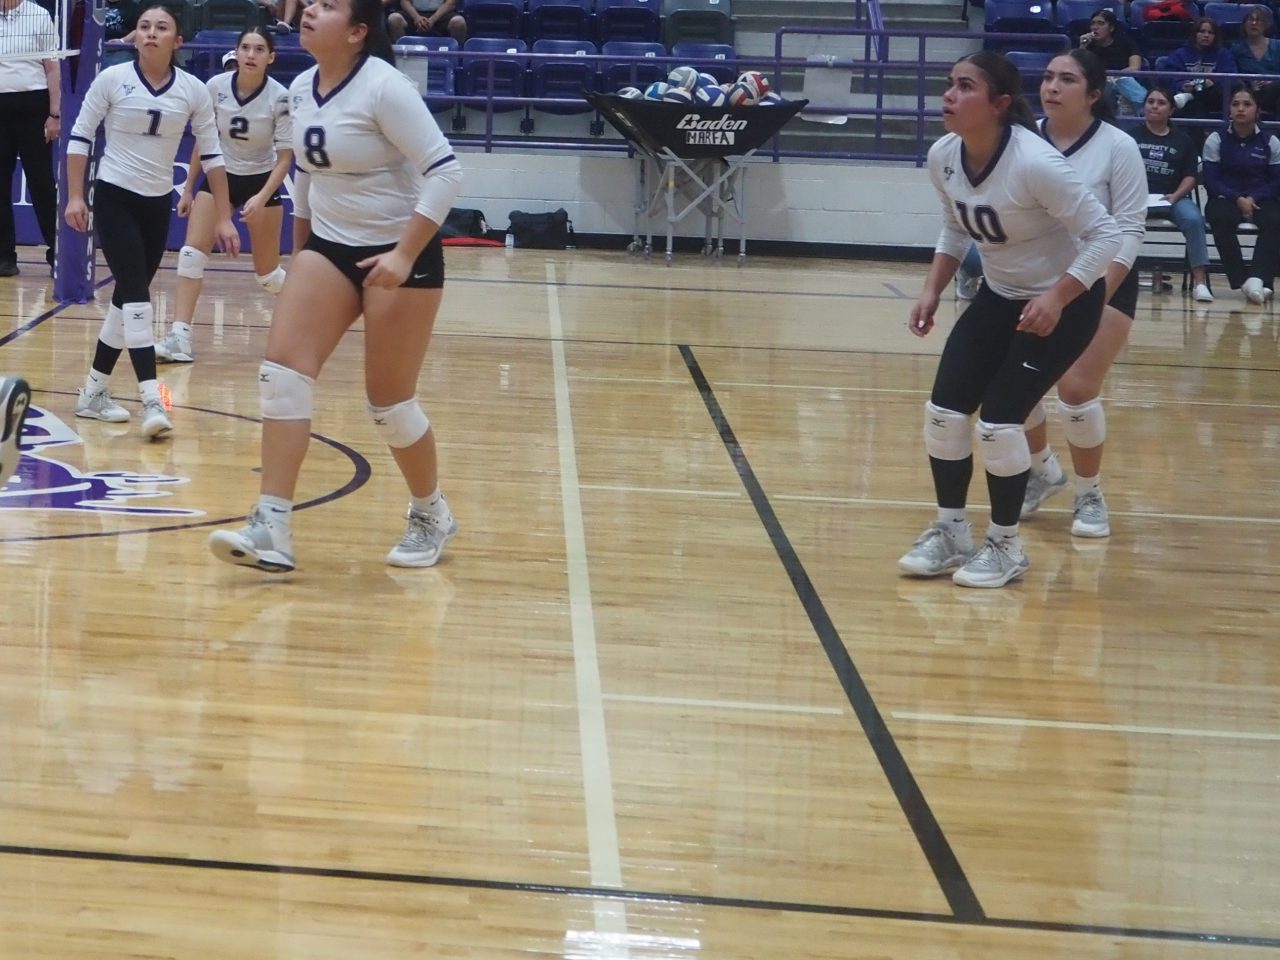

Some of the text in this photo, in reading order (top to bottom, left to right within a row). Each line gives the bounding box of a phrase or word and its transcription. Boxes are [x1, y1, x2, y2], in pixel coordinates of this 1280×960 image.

[141, 109, 162, 136] 1
[228, 116, 250, 141] 2
[676, 114, 748, 130] Baden
[303, 126, 332, 168] 8
[687, 131, 730, 144] MARFA
[955, 200, 1009, 244] 10
